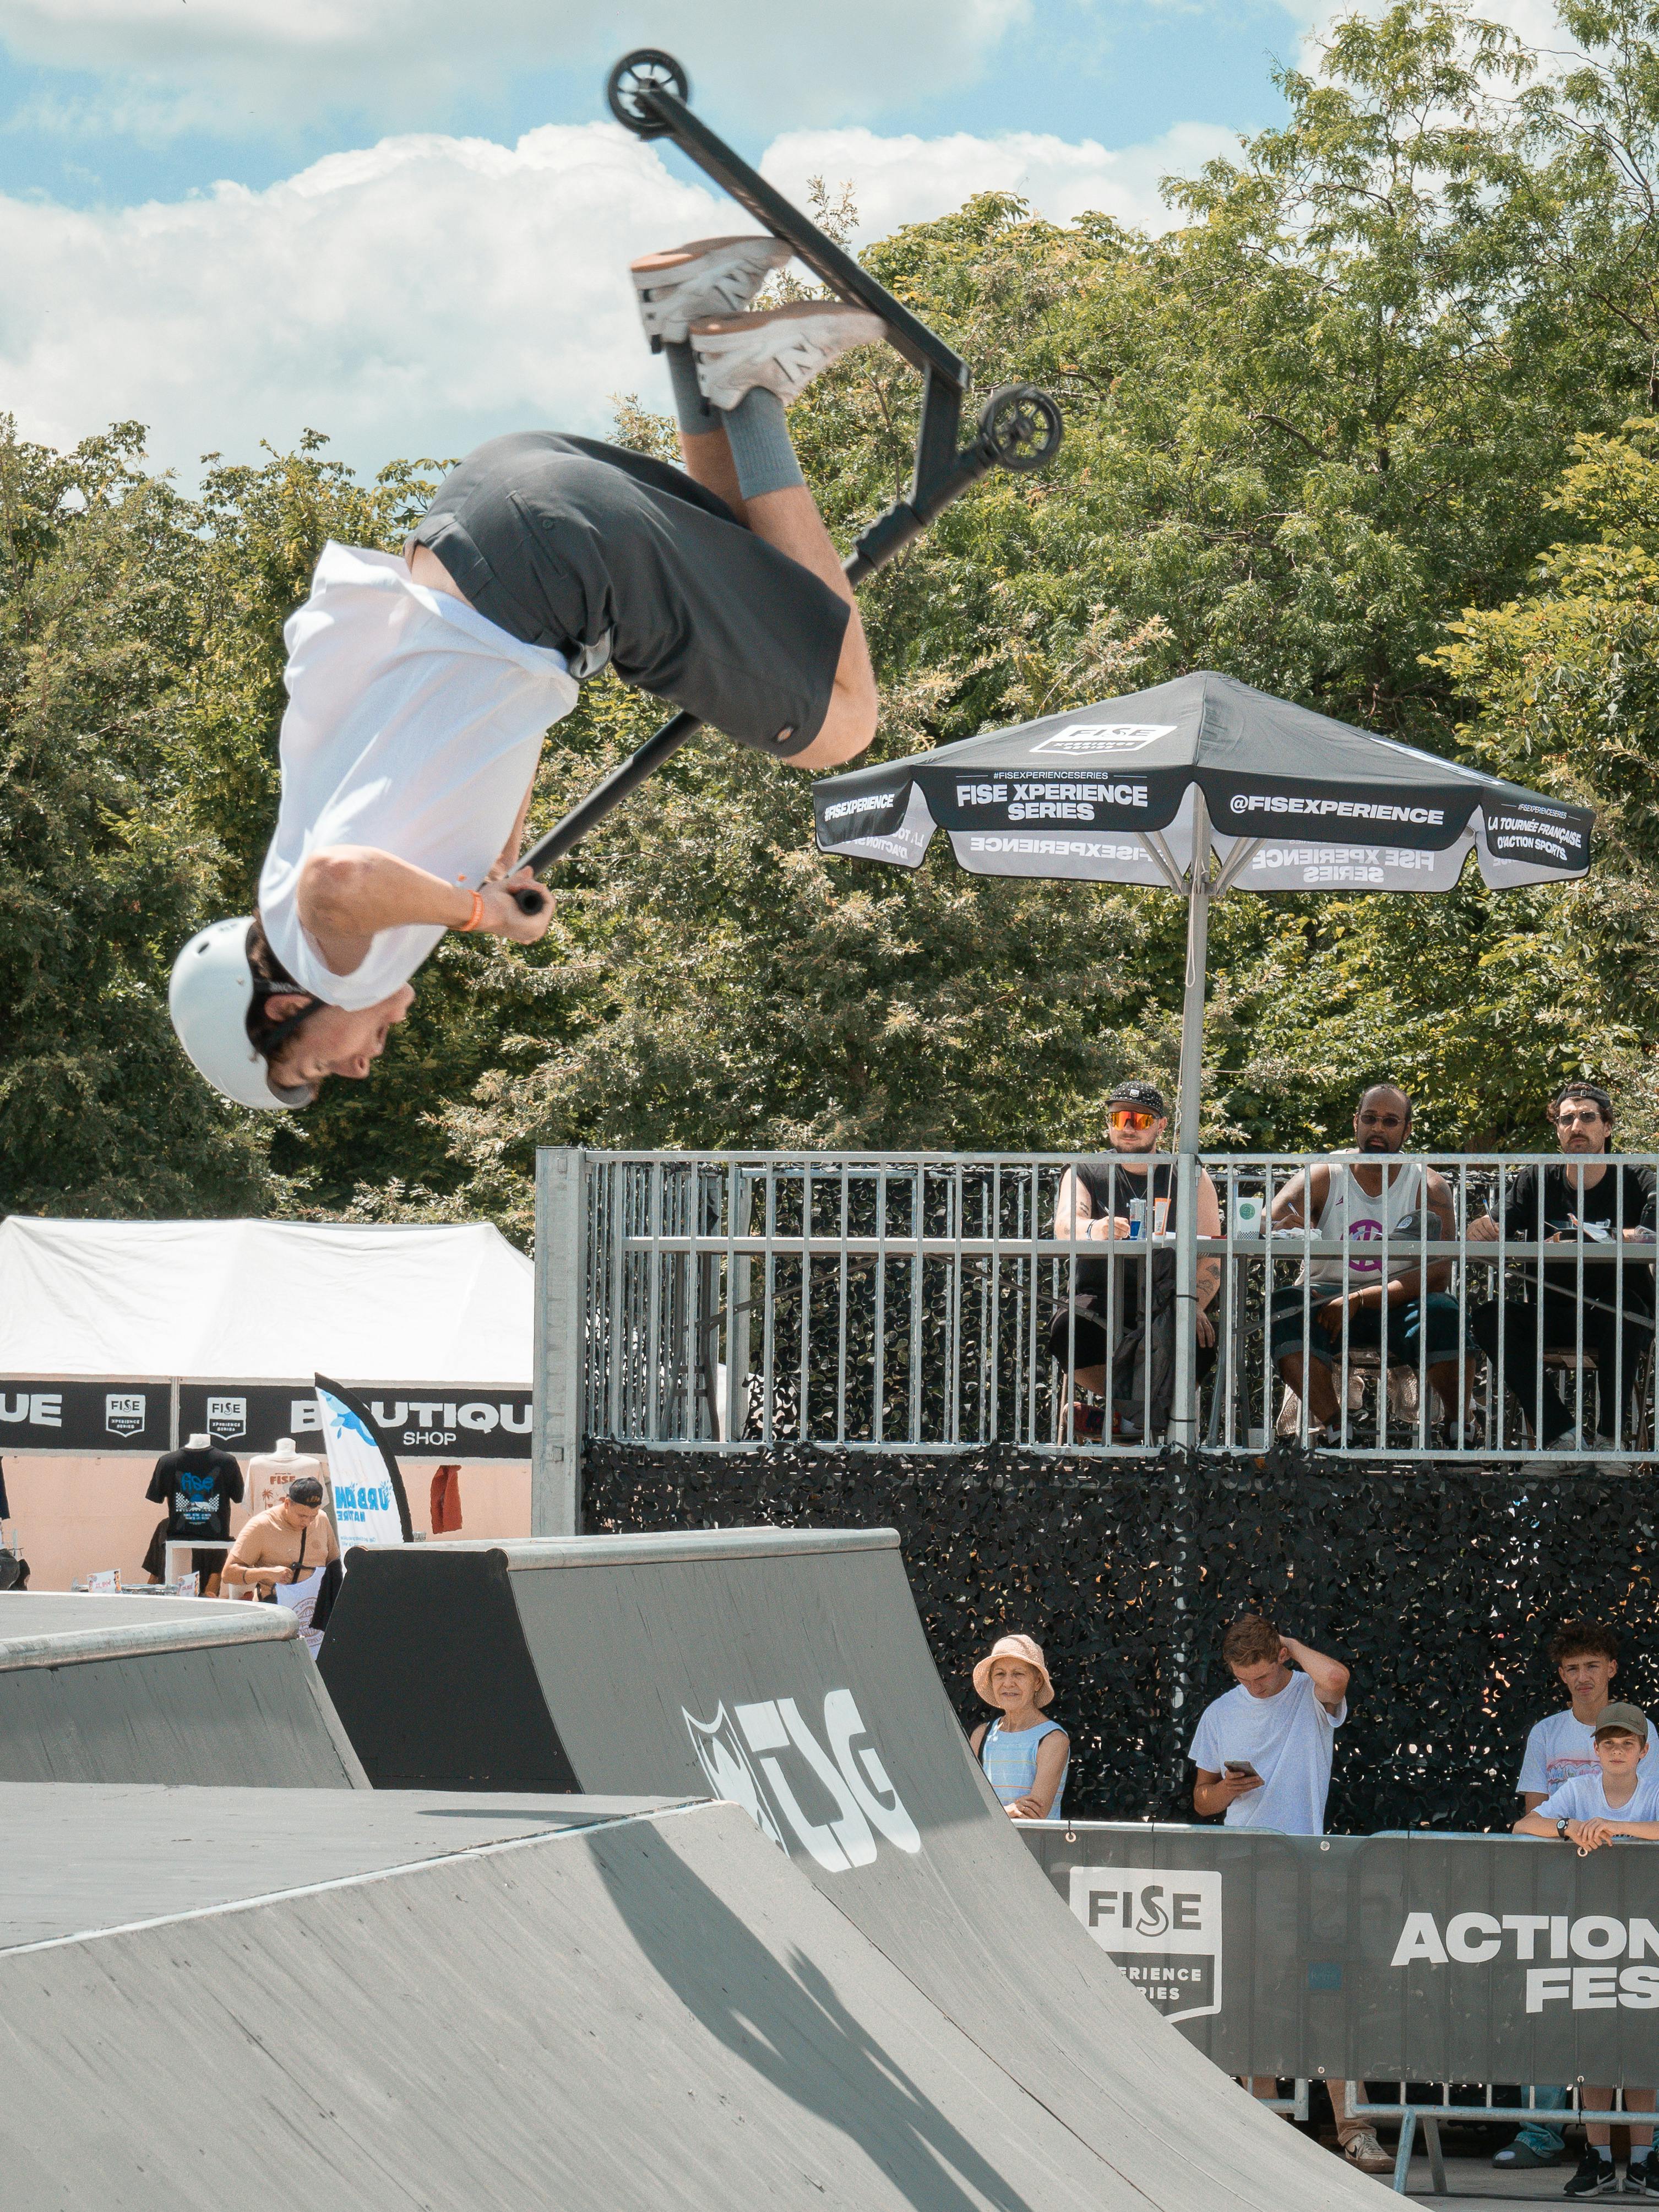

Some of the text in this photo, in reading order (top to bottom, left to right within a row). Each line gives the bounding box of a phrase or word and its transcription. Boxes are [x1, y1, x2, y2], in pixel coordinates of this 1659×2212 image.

[1069, 728, 1156, 737] FISE
[993, 771, 1108, 780] #FISEXPERIENCESERIES
[956, 784, 1148, 807] FISE XPERIENCE
[825, 794, 895, 822] #FISEXPERIENCE
[1008, 802, 1095, 820] SERIES
[1230, 795, 1444, 825] @FISEXPERIENCE
[1517, 803, 1568, 819] #FISEXPERIENCESERIES
[1488, 816, 1582, 849] LA TOURNÉE FRANÇAISE
[1497, 835, 1568, 861] D'ACTION SPORTS
[111, 1399, 140, 1412] FISE
[212, 1403, 241, 1415] FISE
[291, 1400, 532, 1434] BUTIQU
[403, 1432, 456, 1445] SHOP
[1089, 1885, 1201, 1937] FISE
[1390, 1912, 1659, 1966] ACTION
[1117, 1966, 1201, 1981] ERIENCE
[1136, 1986, 1179, 2000] RIES
